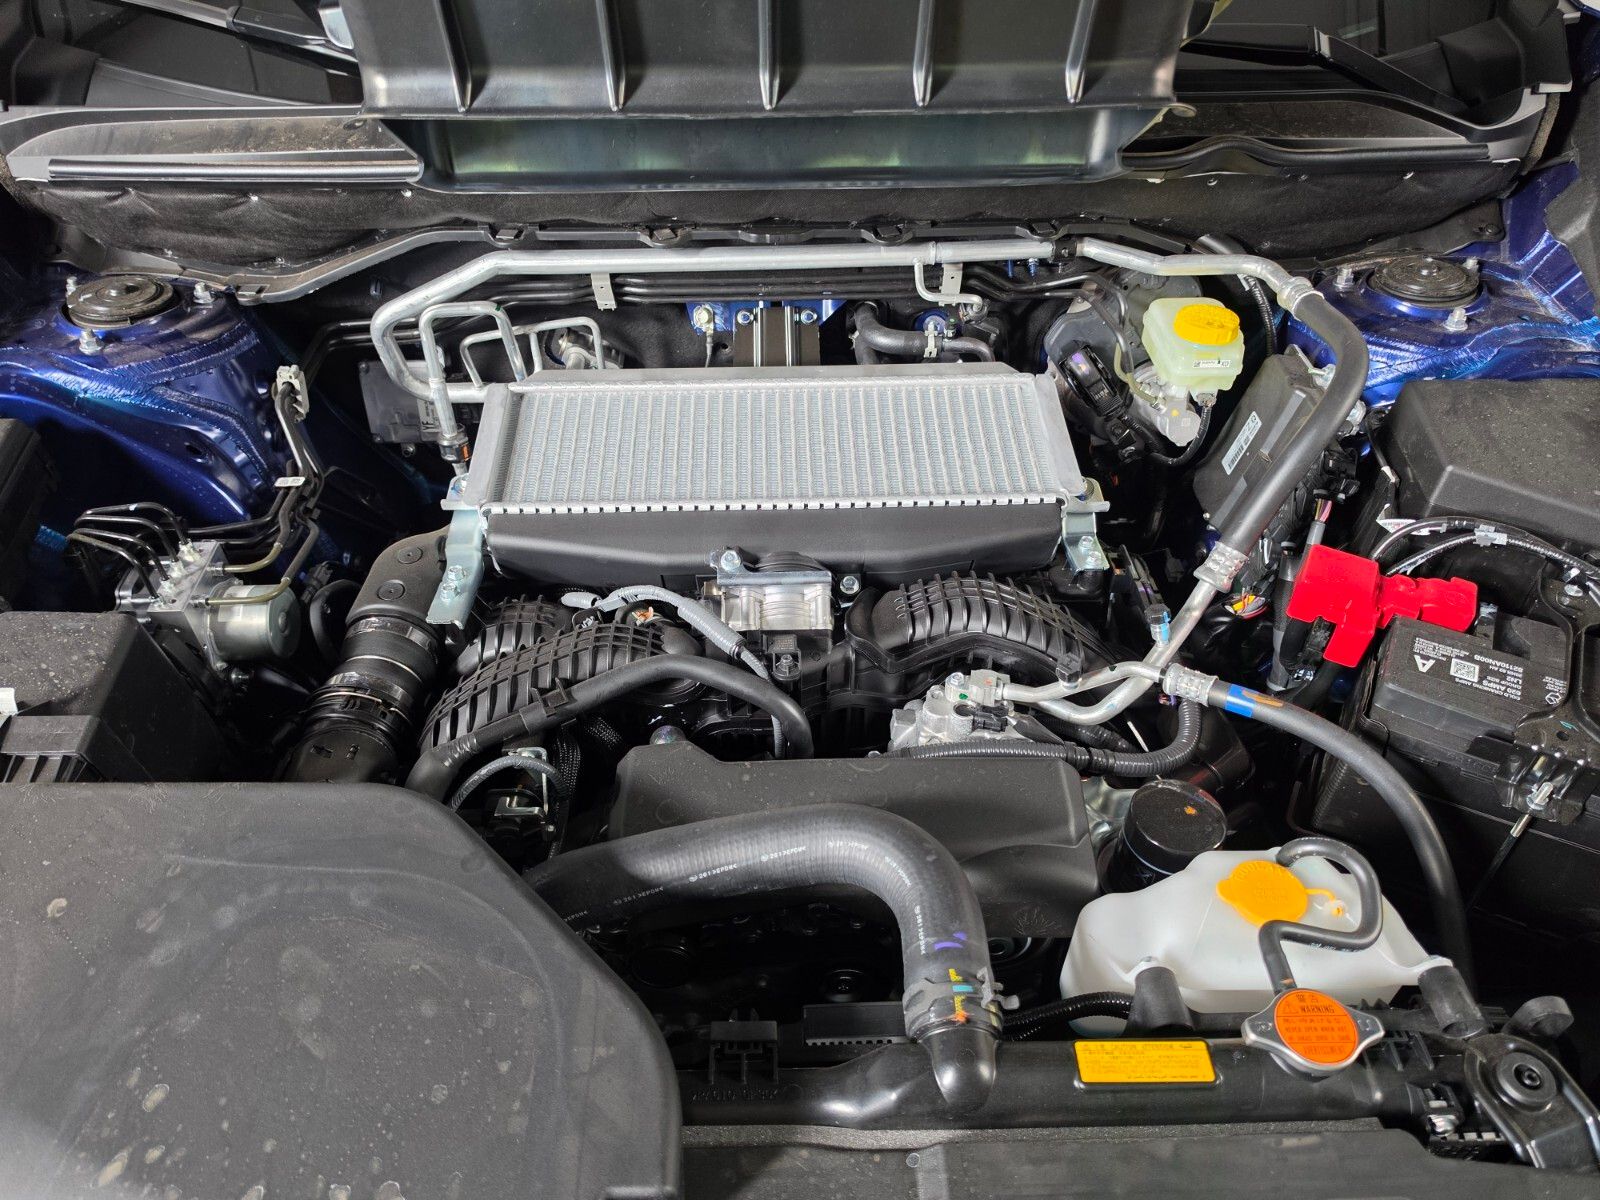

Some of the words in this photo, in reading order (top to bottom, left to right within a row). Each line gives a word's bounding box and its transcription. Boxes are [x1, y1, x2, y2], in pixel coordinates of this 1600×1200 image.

[1414, 654, 1436, 673] A
[1482, 679, 1506, 691] AMPS
[1503, 692, 1521, 701] COLD
